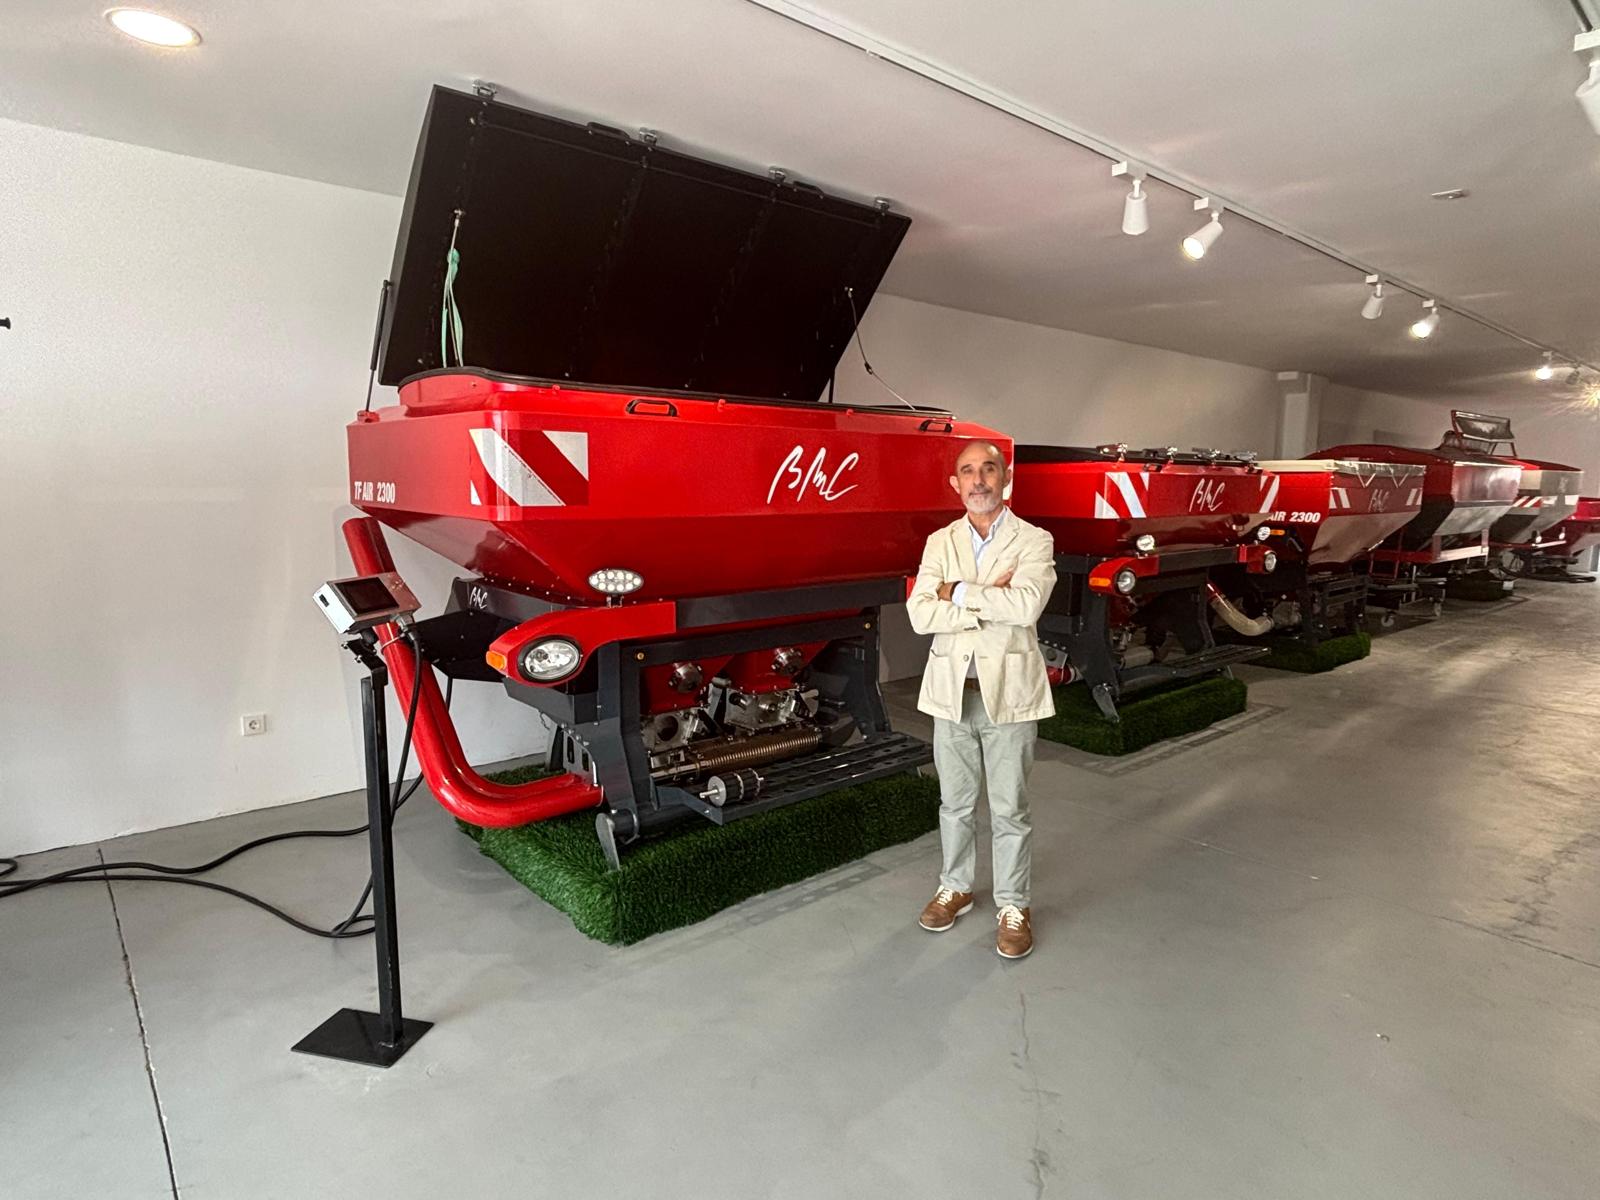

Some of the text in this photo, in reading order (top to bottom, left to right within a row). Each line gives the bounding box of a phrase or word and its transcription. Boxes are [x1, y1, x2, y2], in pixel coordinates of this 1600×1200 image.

[354, 481, 396, 504] TF AIR 2300
[1289, 511, 1321, 523] 2300
